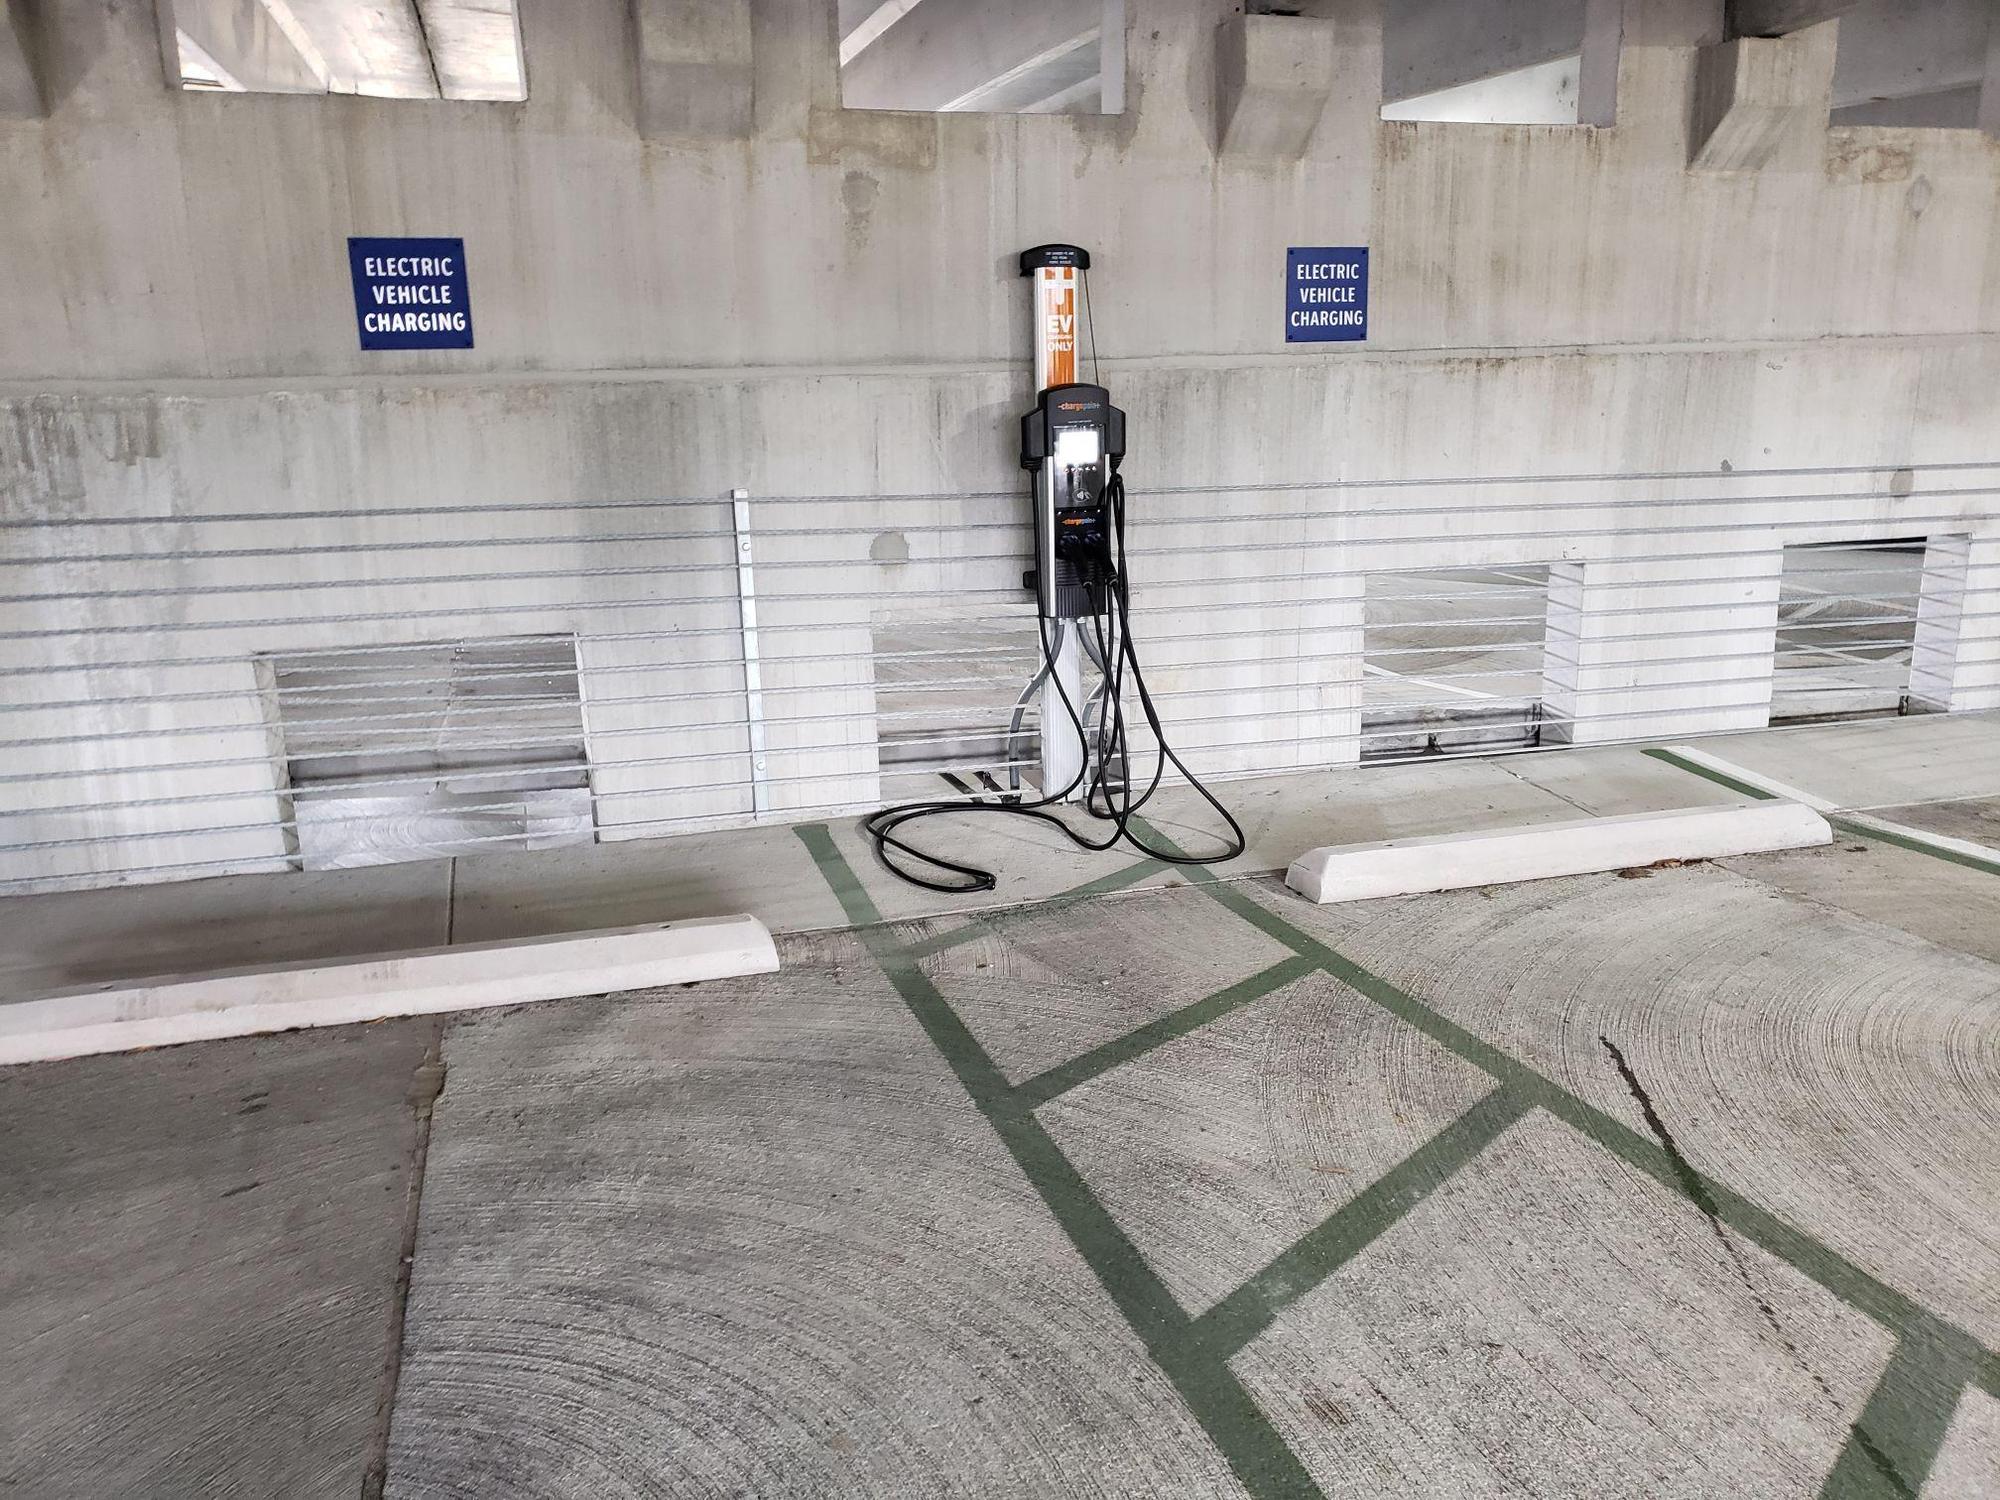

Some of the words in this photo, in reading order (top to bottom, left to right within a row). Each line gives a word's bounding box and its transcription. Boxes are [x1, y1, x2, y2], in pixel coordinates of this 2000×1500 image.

[365, 257, 454, 276] ELECTRIC
[1297, 264, 1360, 279] ELECTRIC
[372, 285, 452, 304] VEHICLE
[1299, 287, 1356, 303] VEHICLE
[364, 312, 466, 332] CHARGING
[1047, 314, 1073, 333] EV
[1291, 310, 1363, 327] CHARGING
[1047, 342, 1073, 352] ONLY
